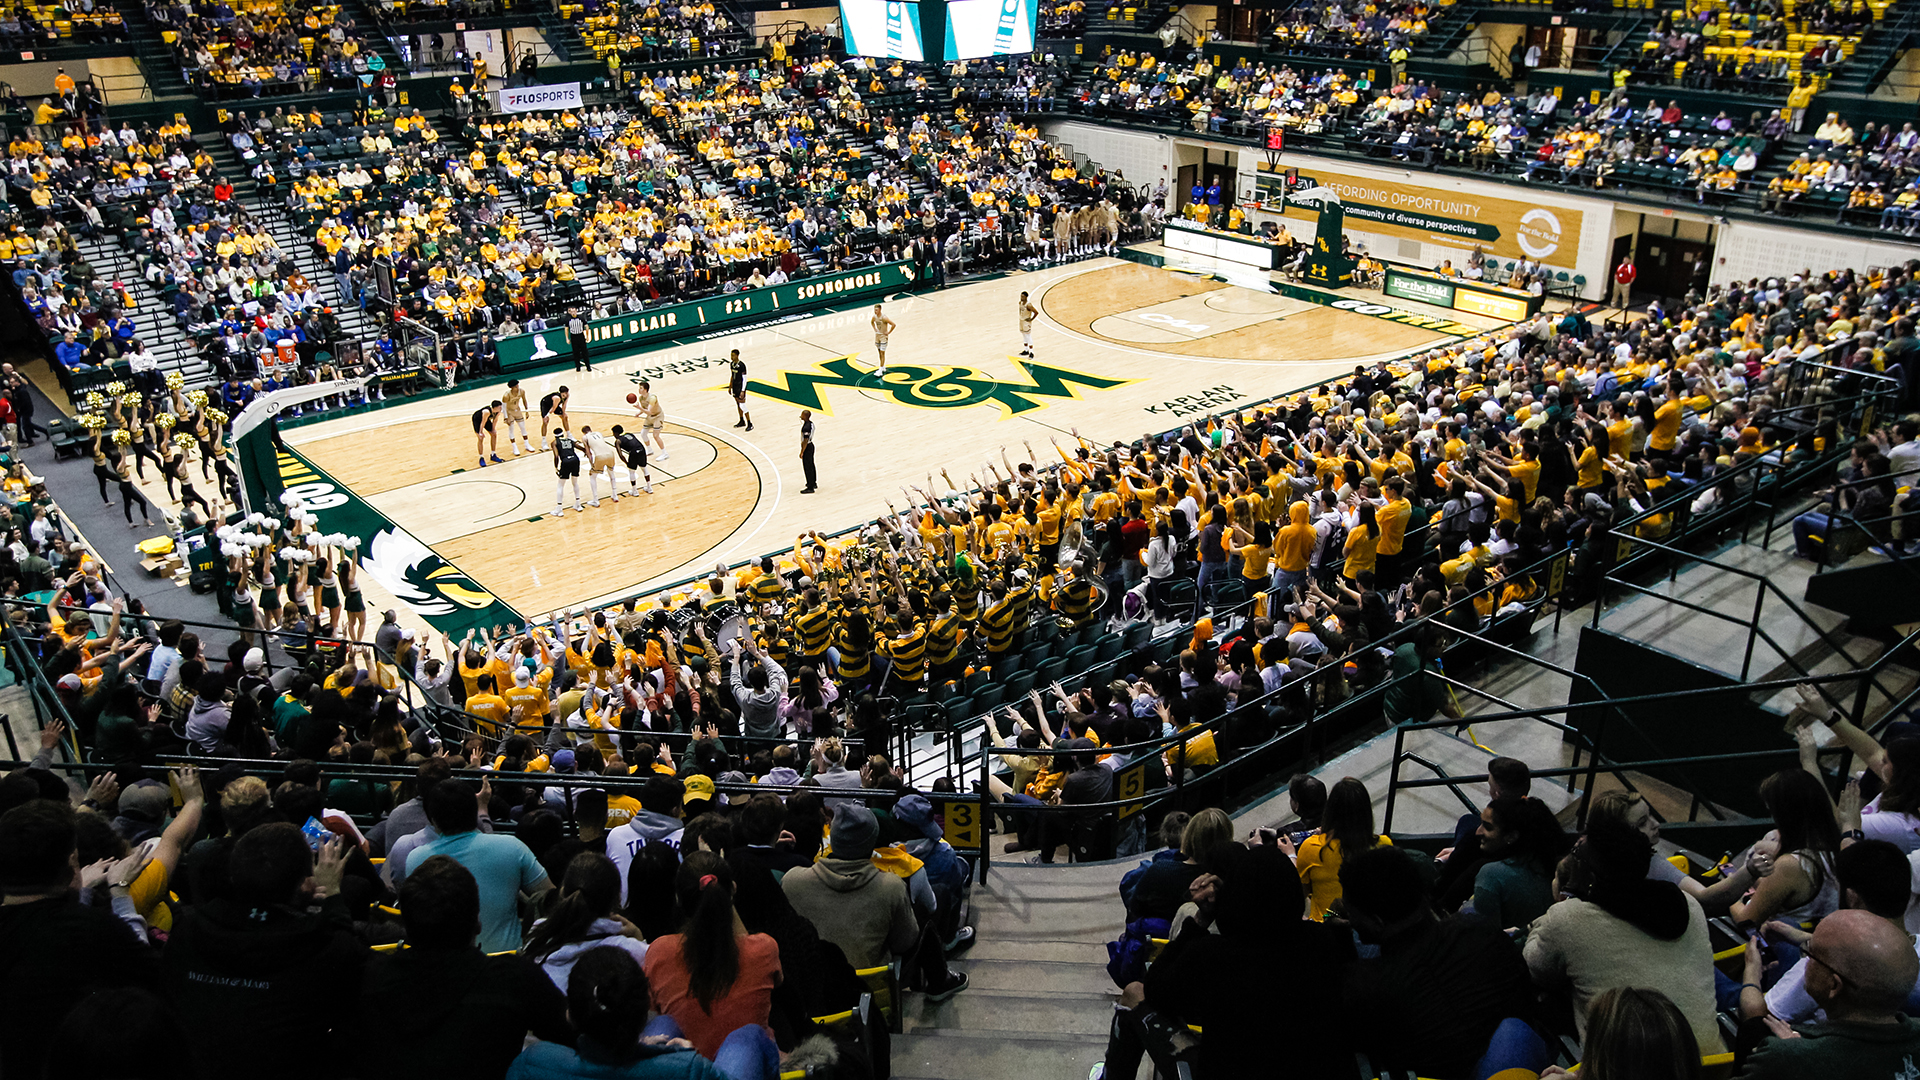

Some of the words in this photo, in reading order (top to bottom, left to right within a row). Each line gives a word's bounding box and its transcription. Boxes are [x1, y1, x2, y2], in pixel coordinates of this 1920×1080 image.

[516, 90, 575, 105] FLOSPORTS
[1268, 134, 1282, 149] 30
[1323, 182, 1388, 203] AFFORDING
[1391, 192, 1481, 218] OPPORTUNITY
[1345, 206, 1386, 221] community
[1387, 213, 1396, 221] of
[1397, 213, 1425, 226] diverse
[1426, 220, 1477, 235] perspectives
[1391, 277, 1410, 288] For
[1410, 281, 1426, 292] the
[1426, 284, 1450, 298] Bold
[584, 323, 623, 344] UINN
[629, 312, 678, 335] BLAIR
[725, 297, 752, 315] #21
[797, 272, 882, 300] SOPHOMORE
[1330, 300, 1391, 315] GO
[1144, 384, 1235, 415] KAPLAN
[1172, 392, 1248, 418] ARENA
[199, 561, 213, 572] TRI
[1125, 769, 1140, 797] 5
[608, 808, 631, 818] REN
[952, 804, 973, 827] 3
[187, 970, 230, 986] WILLIAM
[230, 979, 241, 987] &
[241, 978, 272, 990] MARY
